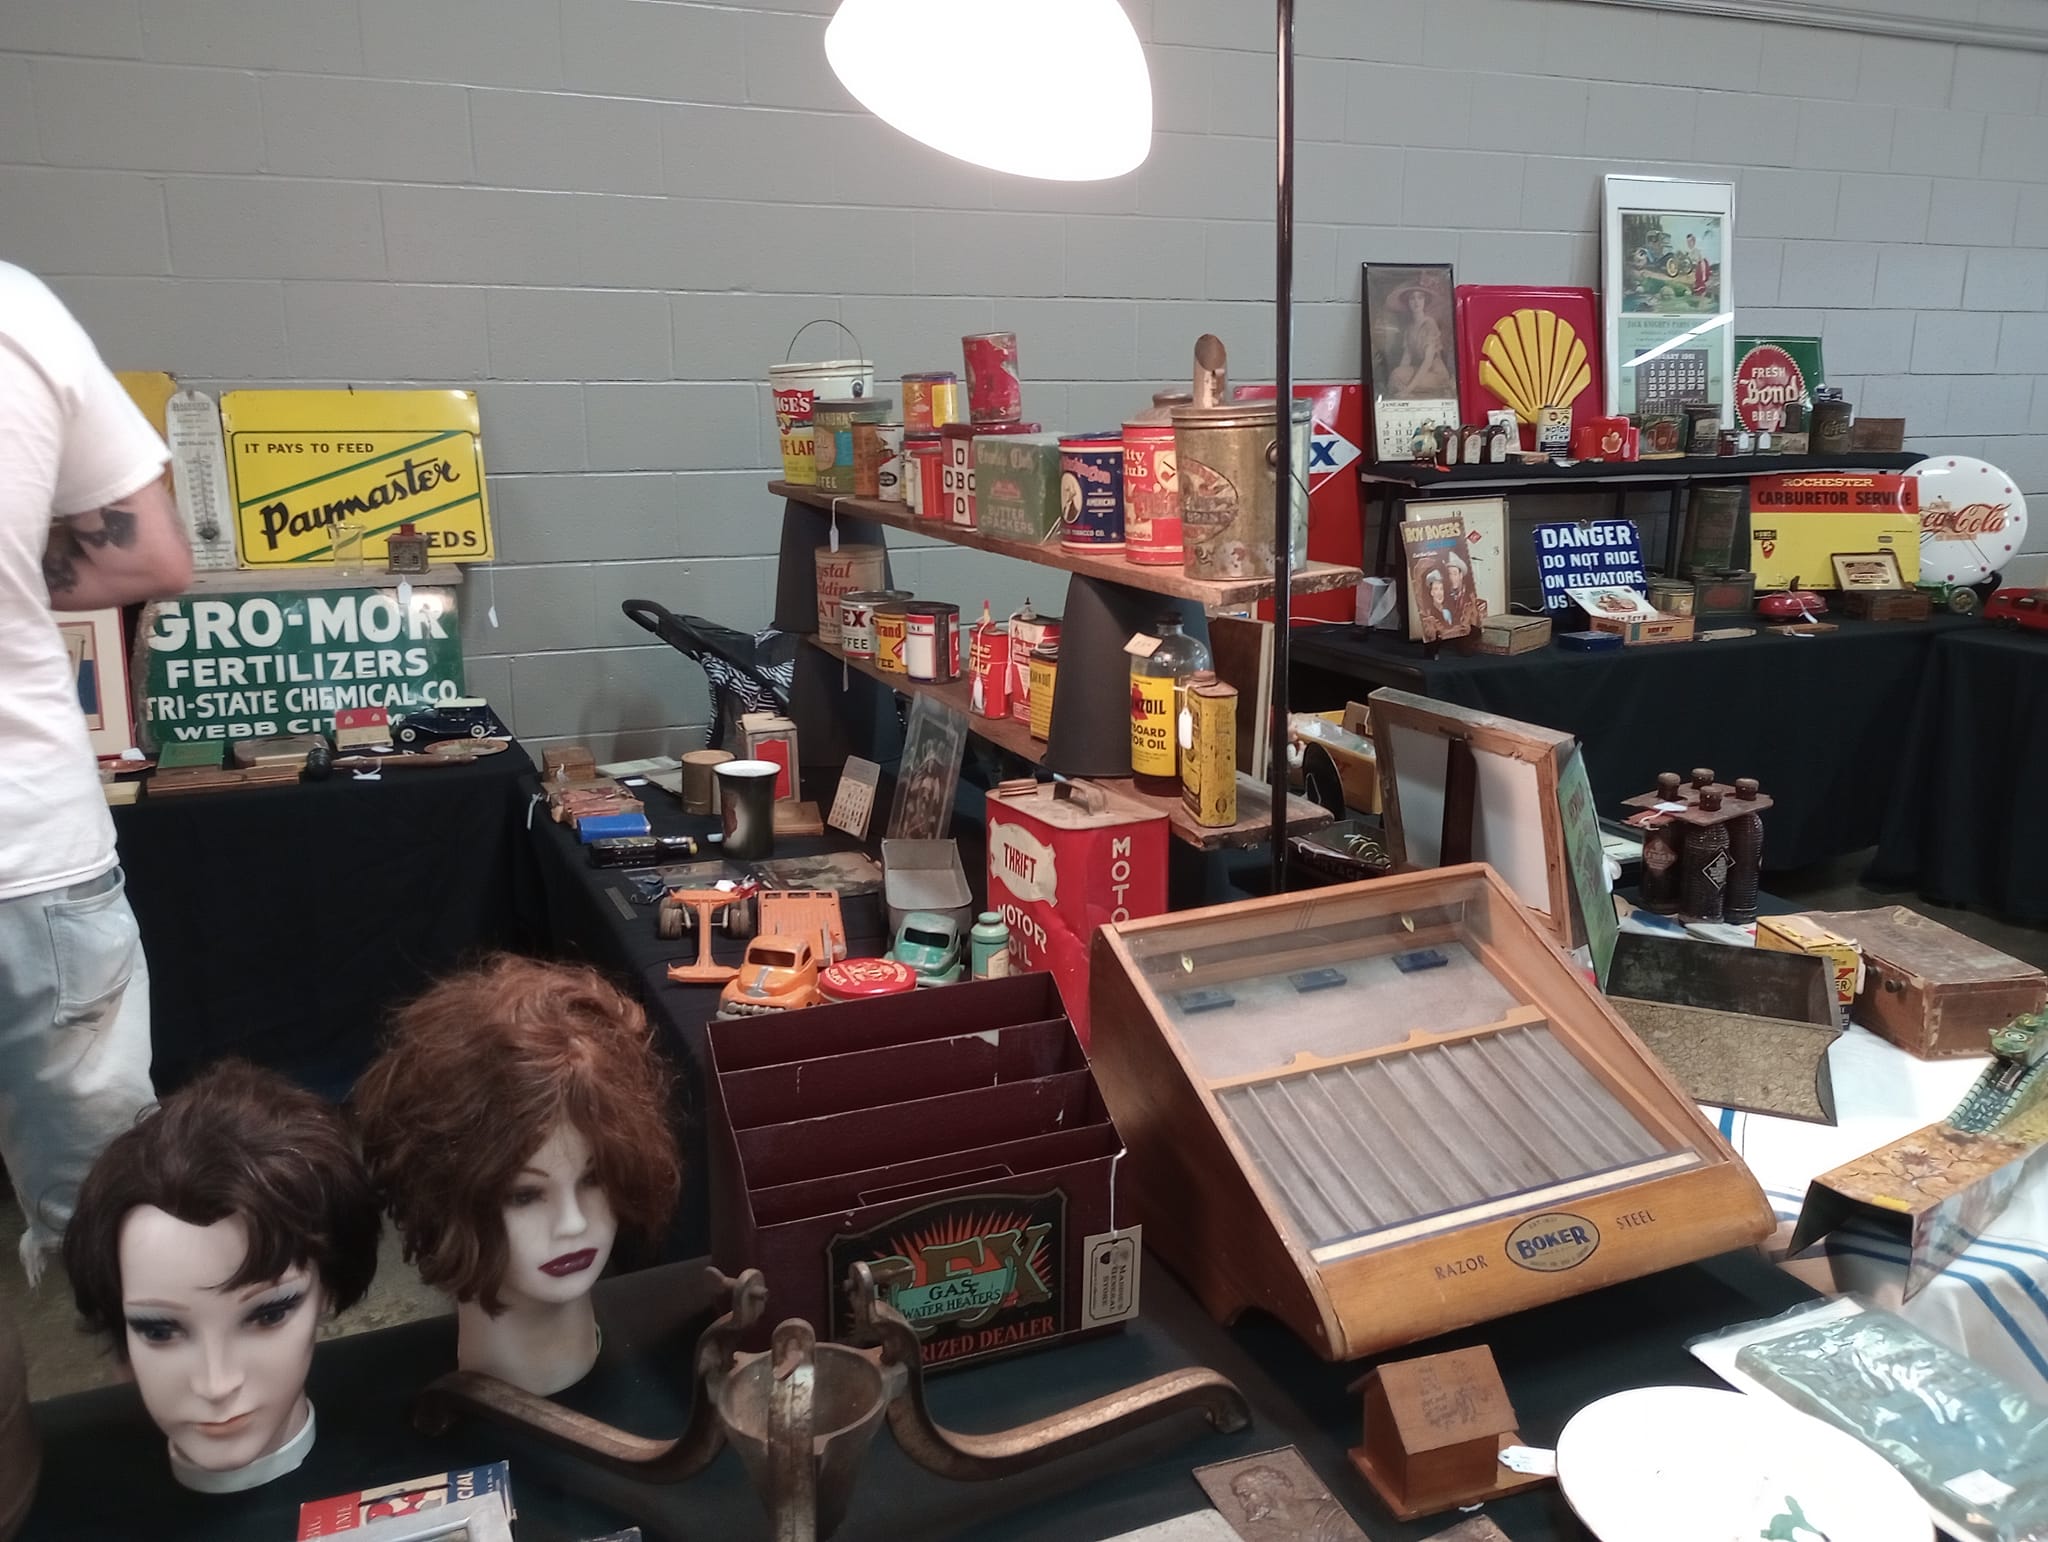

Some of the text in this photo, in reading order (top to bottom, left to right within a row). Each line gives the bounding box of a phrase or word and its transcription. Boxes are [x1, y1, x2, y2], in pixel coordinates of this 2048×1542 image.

[1751, 366, 1786, 378] FRESH
[1740, 375, 1799, 405] Bond
[776, 393, 812, 413] GE'S
[1751, 410, 1779, 421] BREA
[245, 443, 374, 454] IT PAYS TO FEED
[792, 440, 815, 456] LAR
[1782, 478, 1875, 487] ROCHESTER
[259, 457, 460, 550] Paymaster
[1757, 491, 1848, 505] CARBURETOR
[987, 504, 1025, 521] BUTTER
[981, 515, 1034, 535] CRACKERS
[1404, 522, 1461, 543] ROY ROGERS
[430, 530, 477, 548] EDS
[1540, 525, 1633, 549] DANGER
[1543, 551, 1640, 569] DO NOT RIDE
[817, 561, 853, 583] ystal
[1545, 571, 1647, 589] ON ELEVATORS.
[147, 594, 449, 652] GRO-MOR
[842, 609, 866, 627] EX
[876, 624, 902, 638] rand
[166, 648, 429, 689] FERTILIZERS
[147, 689, 278, 721] TRI-STATE
[285, 682, 411, 712] CHEMICAL
[173, 719, 278, 741] WEBB
[287, 717, 336, 735] CIT
[1132, 723, 1166, 738] BOARD
[1147, 739, 1167, 750] OIL
[1003, 843, 1037, 883] THRIFT
[1111, 836, 1131, 923] MOTO
[997, 903, 1047, 954] MOTOR
[1008, 935, 1033, 967] OIL
[1615, 1209, 1656, 1230] STEEL
[1515, 1225, 1591, 1260] BOKER
[1434, 1255, 1489, 1280] RAZOR
[929, 1279, 973, 1300] GAS
[903, 1289, 1001, 1319] WATER HEATERS
[921, 1316, 1055, 1362] RIZED DEALER
[456, 1471, 474, 1501] CIAL
